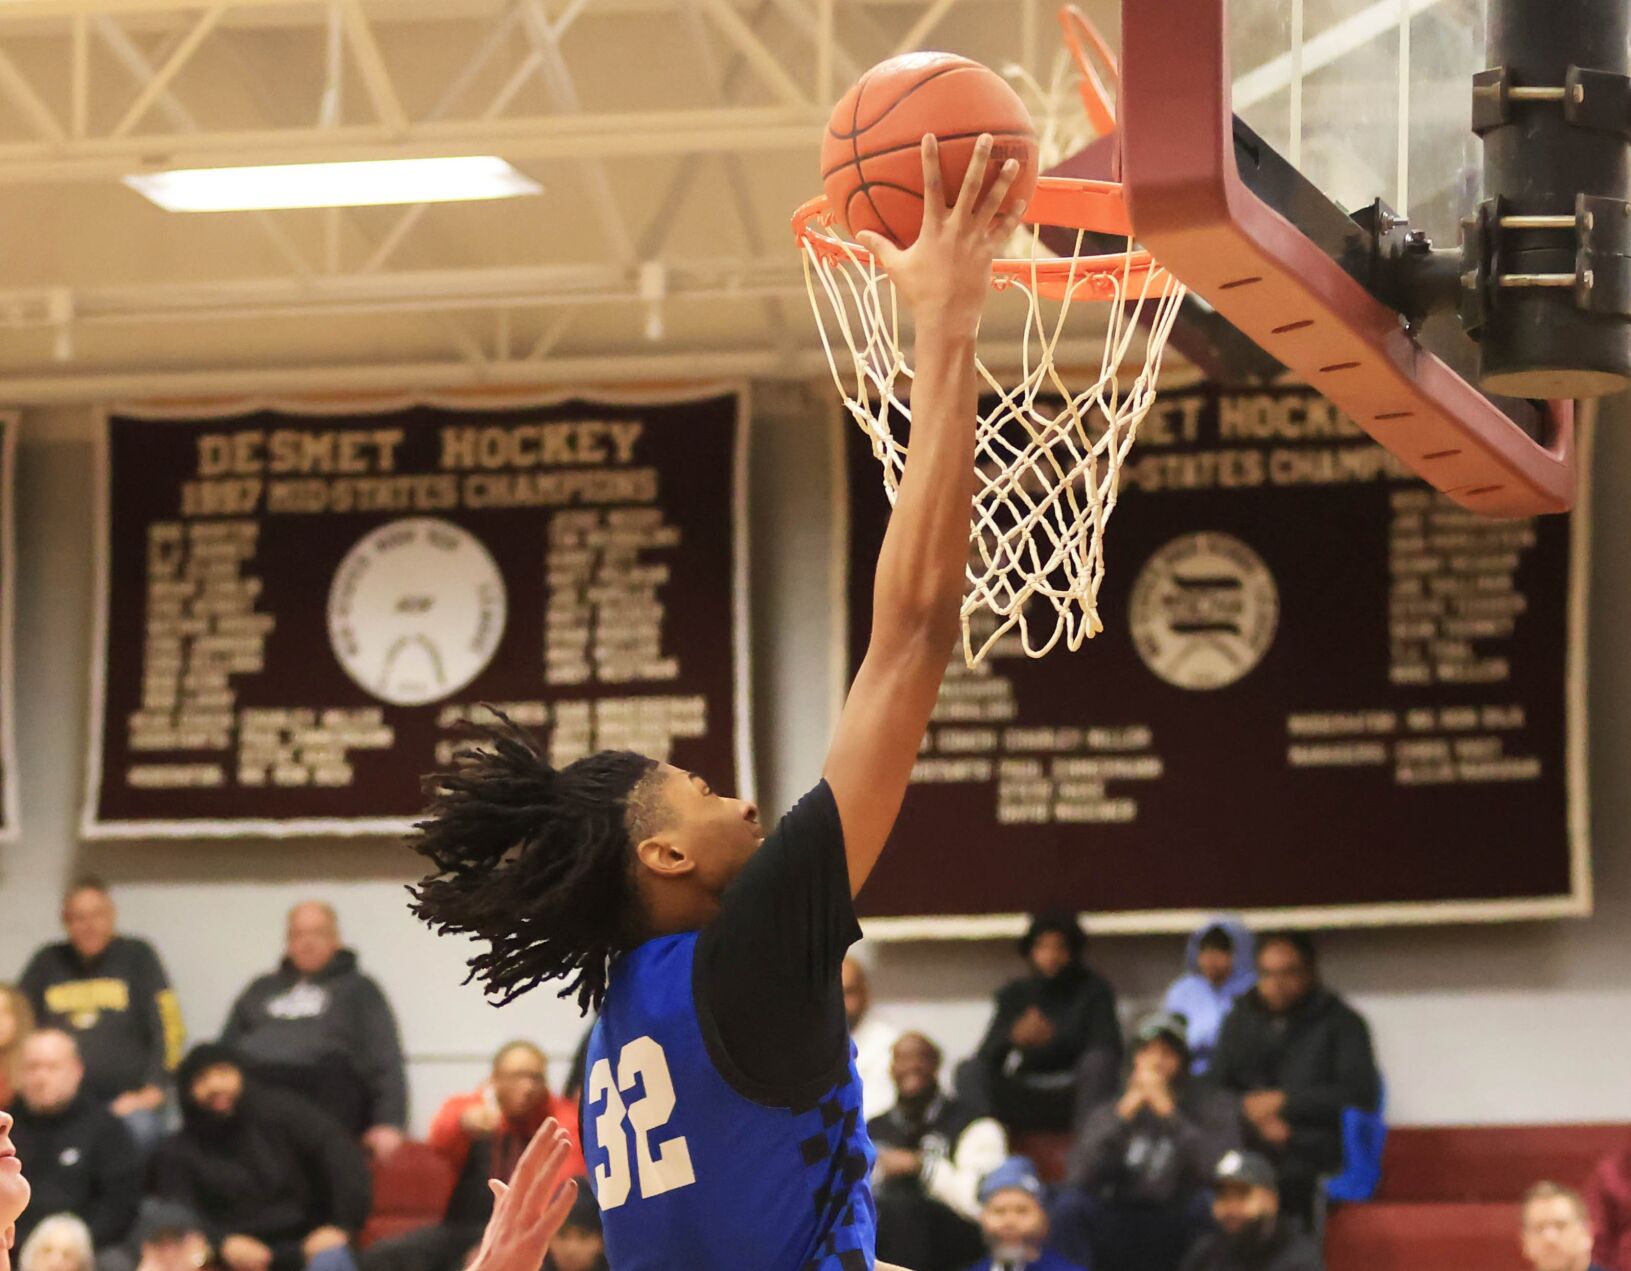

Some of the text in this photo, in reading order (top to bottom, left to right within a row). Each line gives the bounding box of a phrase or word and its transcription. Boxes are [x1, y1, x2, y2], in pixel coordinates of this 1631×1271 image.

[197, 421, 642, 477] DESMET HOCKEY
[463, 468, 657, 509] CHAMPIONS
[588, 1035, 696, 1212] 32
